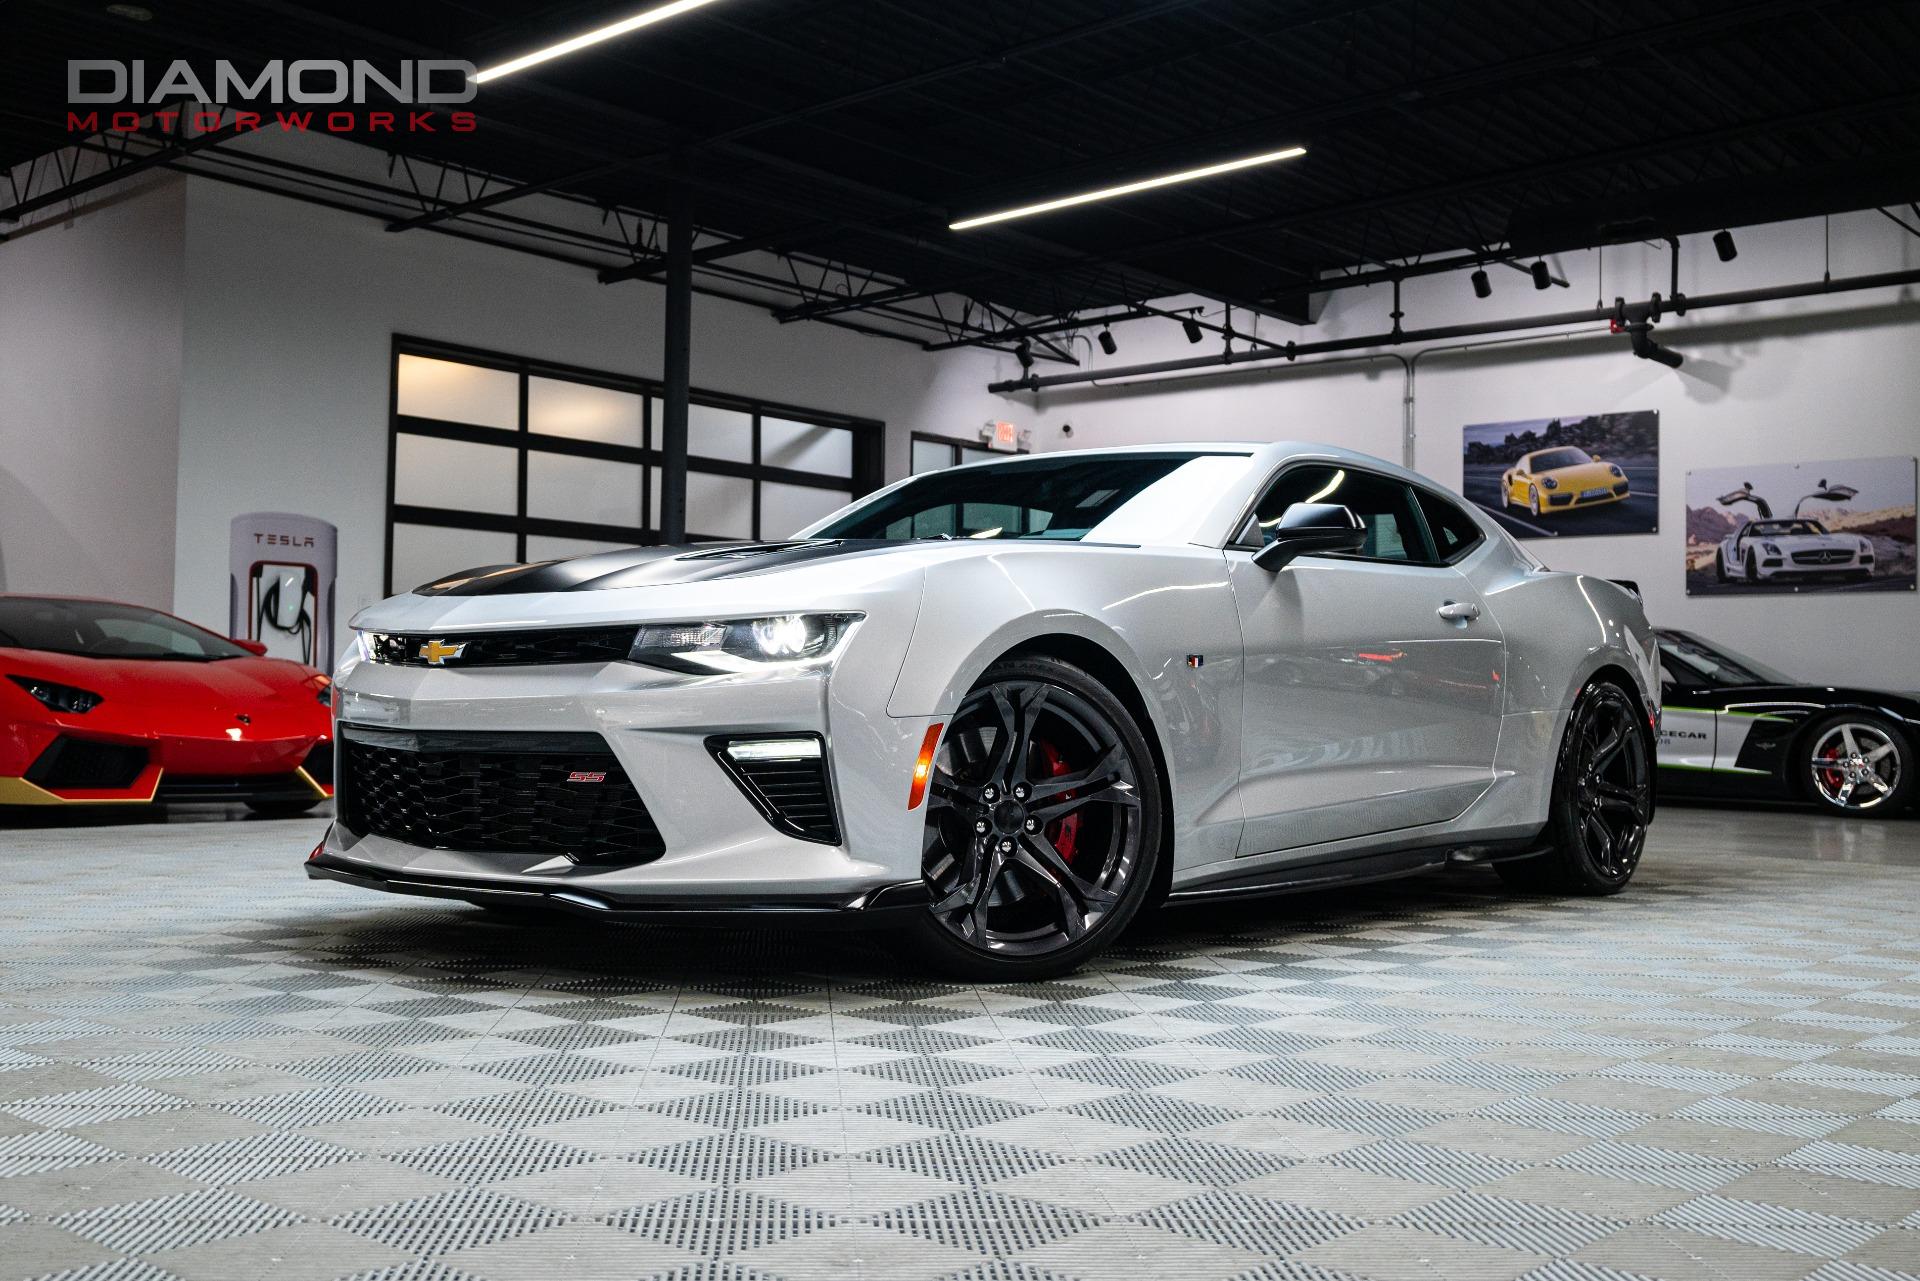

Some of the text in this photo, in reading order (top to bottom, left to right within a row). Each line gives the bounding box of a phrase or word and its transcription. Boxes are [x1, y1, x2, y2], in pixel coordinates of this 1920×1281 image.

[254, 533, 314, 548] TESLA
[1660, 730, 1707, 739] CECAR
[567, 771, 607, 783] SS
